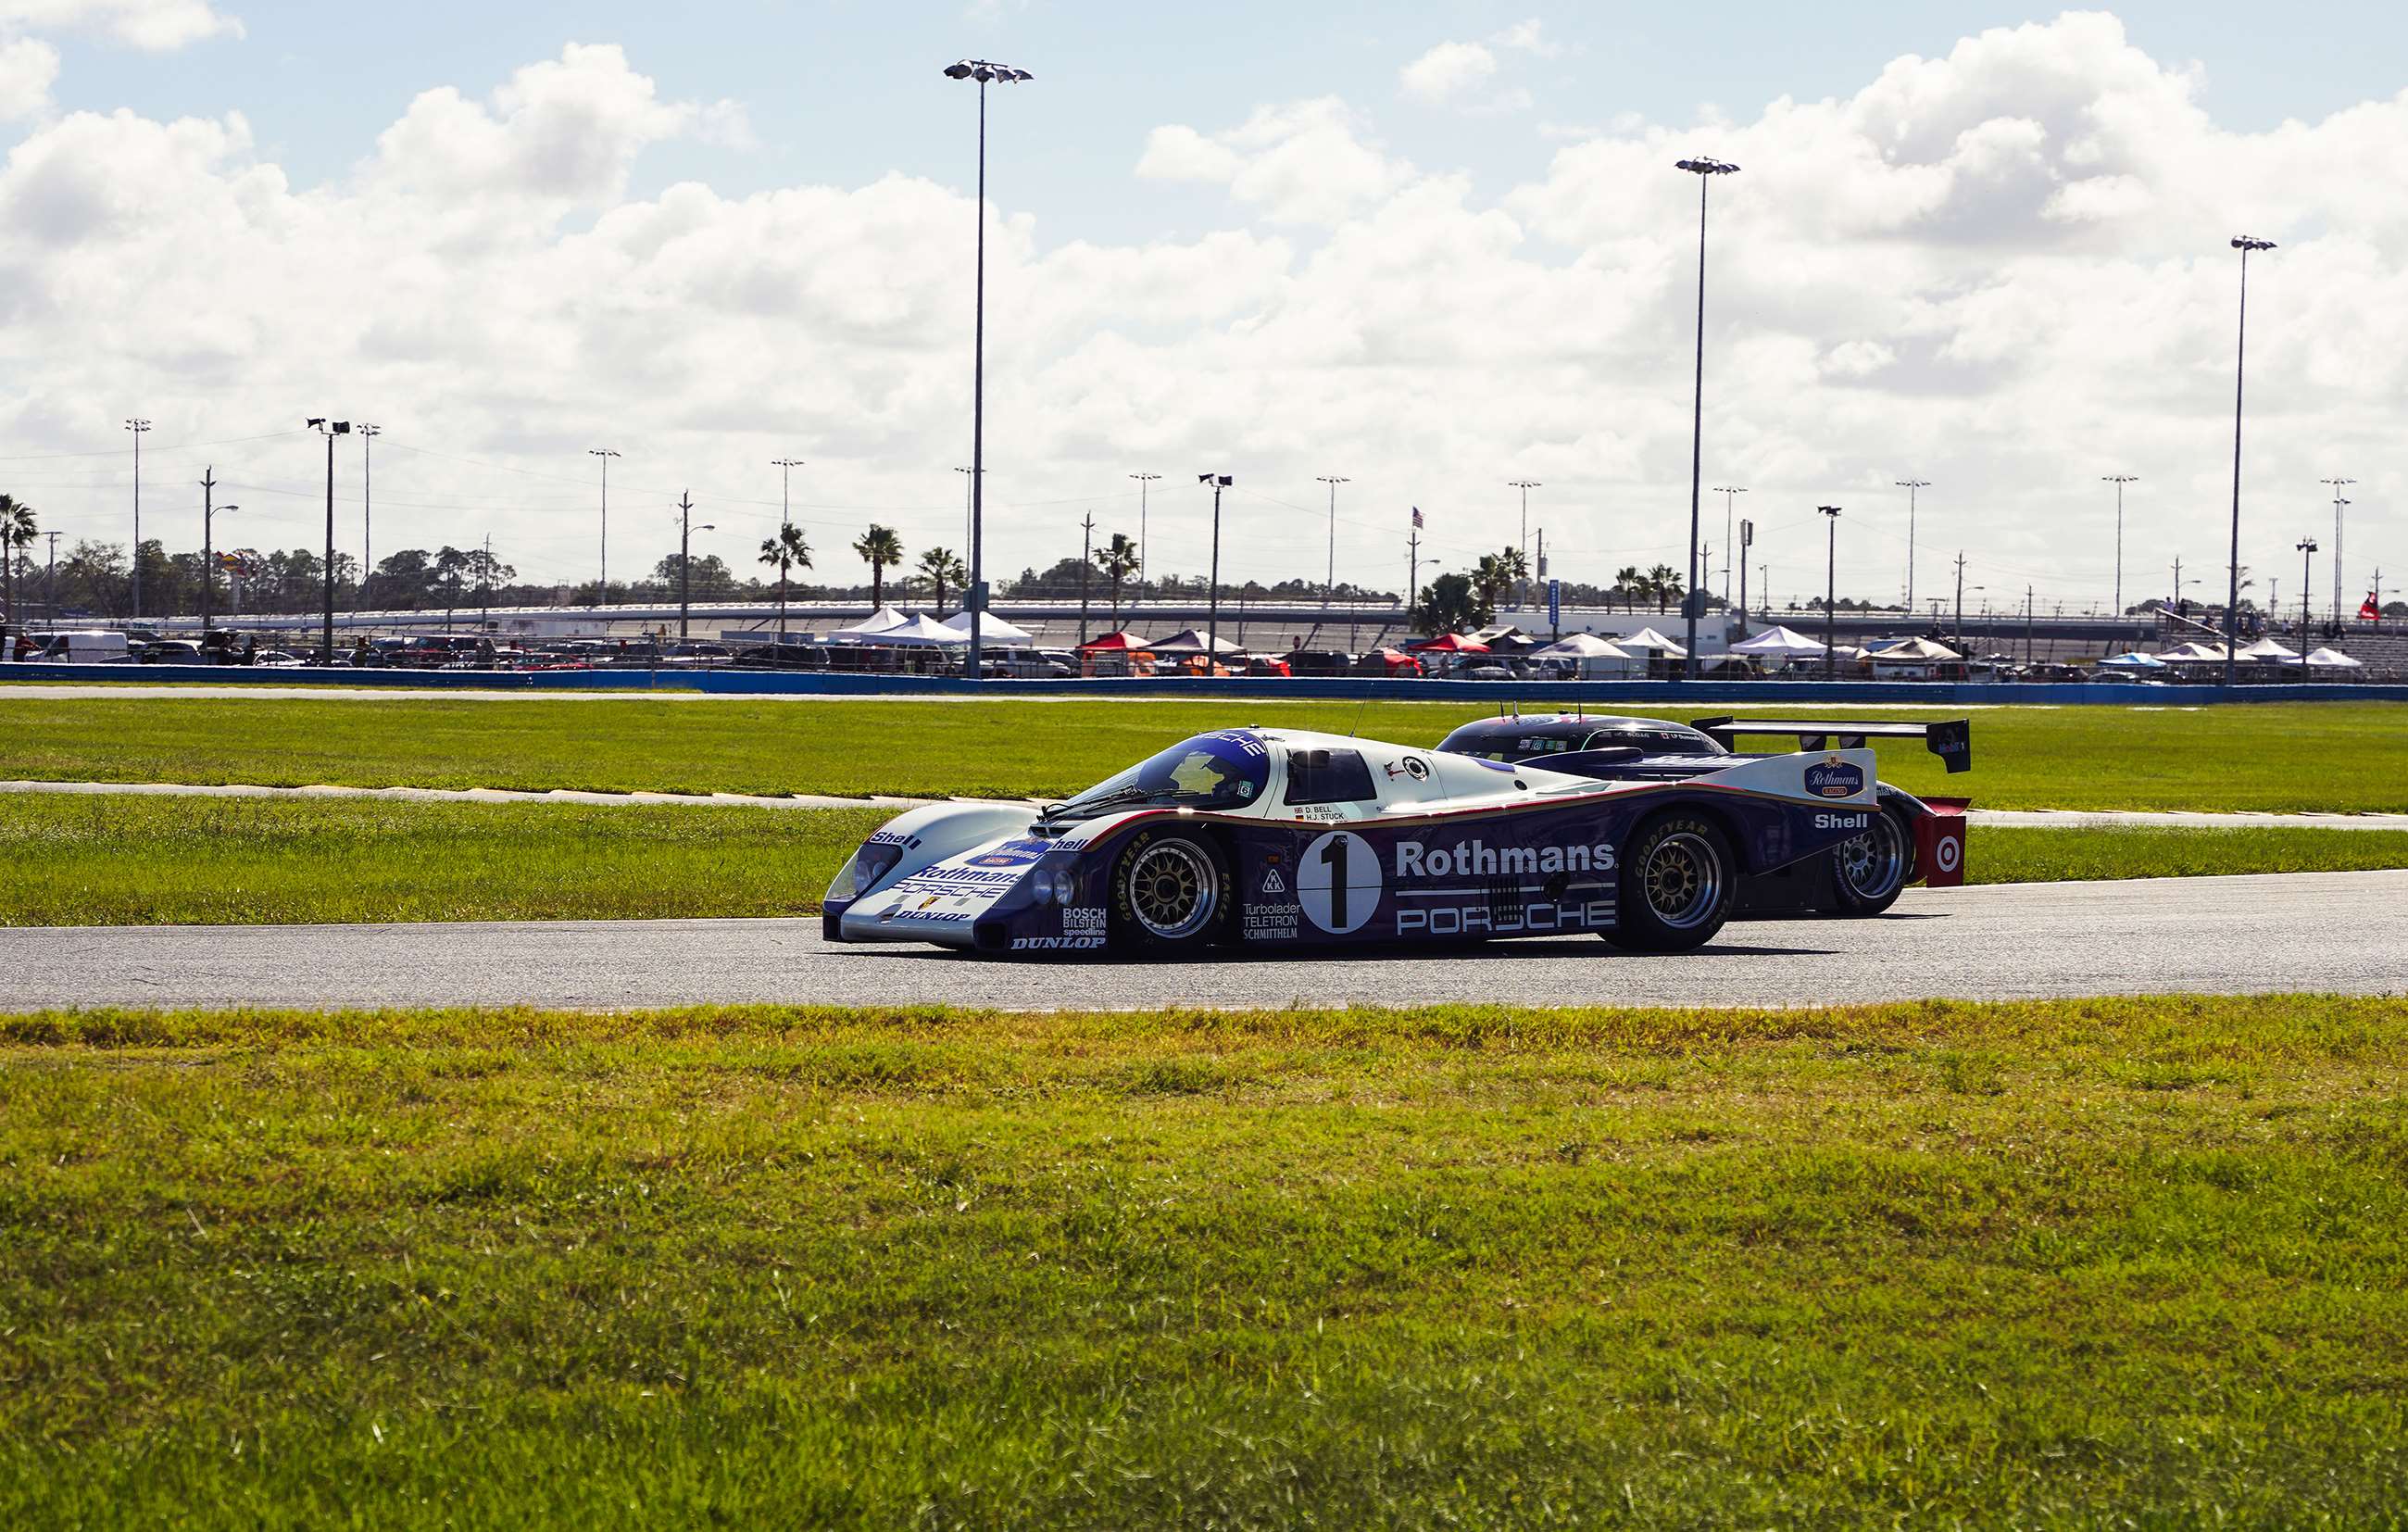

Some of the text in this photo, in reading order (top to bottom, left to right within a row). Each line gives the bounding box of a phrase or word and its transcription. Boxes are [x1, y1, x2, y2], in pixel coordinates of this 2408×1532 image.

[1200, 732, 1265, 757] SCHE
[1810, 770, 1859, 785] Rothmans
[1815, 814, 1868, 829] Shell
[871, 832, 922, 850] Shell
[1051, 838, 1089, 849] hell
[1397, 839, 1615, 876] Rothmans
[1321, 835, 1348, 928] 1
[889, 882, 1007, 898] PORSCHE
[1062, 908, 1107, 919] BOSCH
[1243, 902, 1301, 915] Turbolader
[894, 910, 972, 921] DUNLOP
[1243, 915, 1298, 927] TELETRON
[1397, 900, 1616, 936] PORSCHE
[1062, 919, 1107, 928] BILSTEIN
[1063, 927, 1106, 936] speedline
[1243, 927, 1298, 940] SCHMITTHELM
[1010, 937, 1106, 949] DUNLOP
